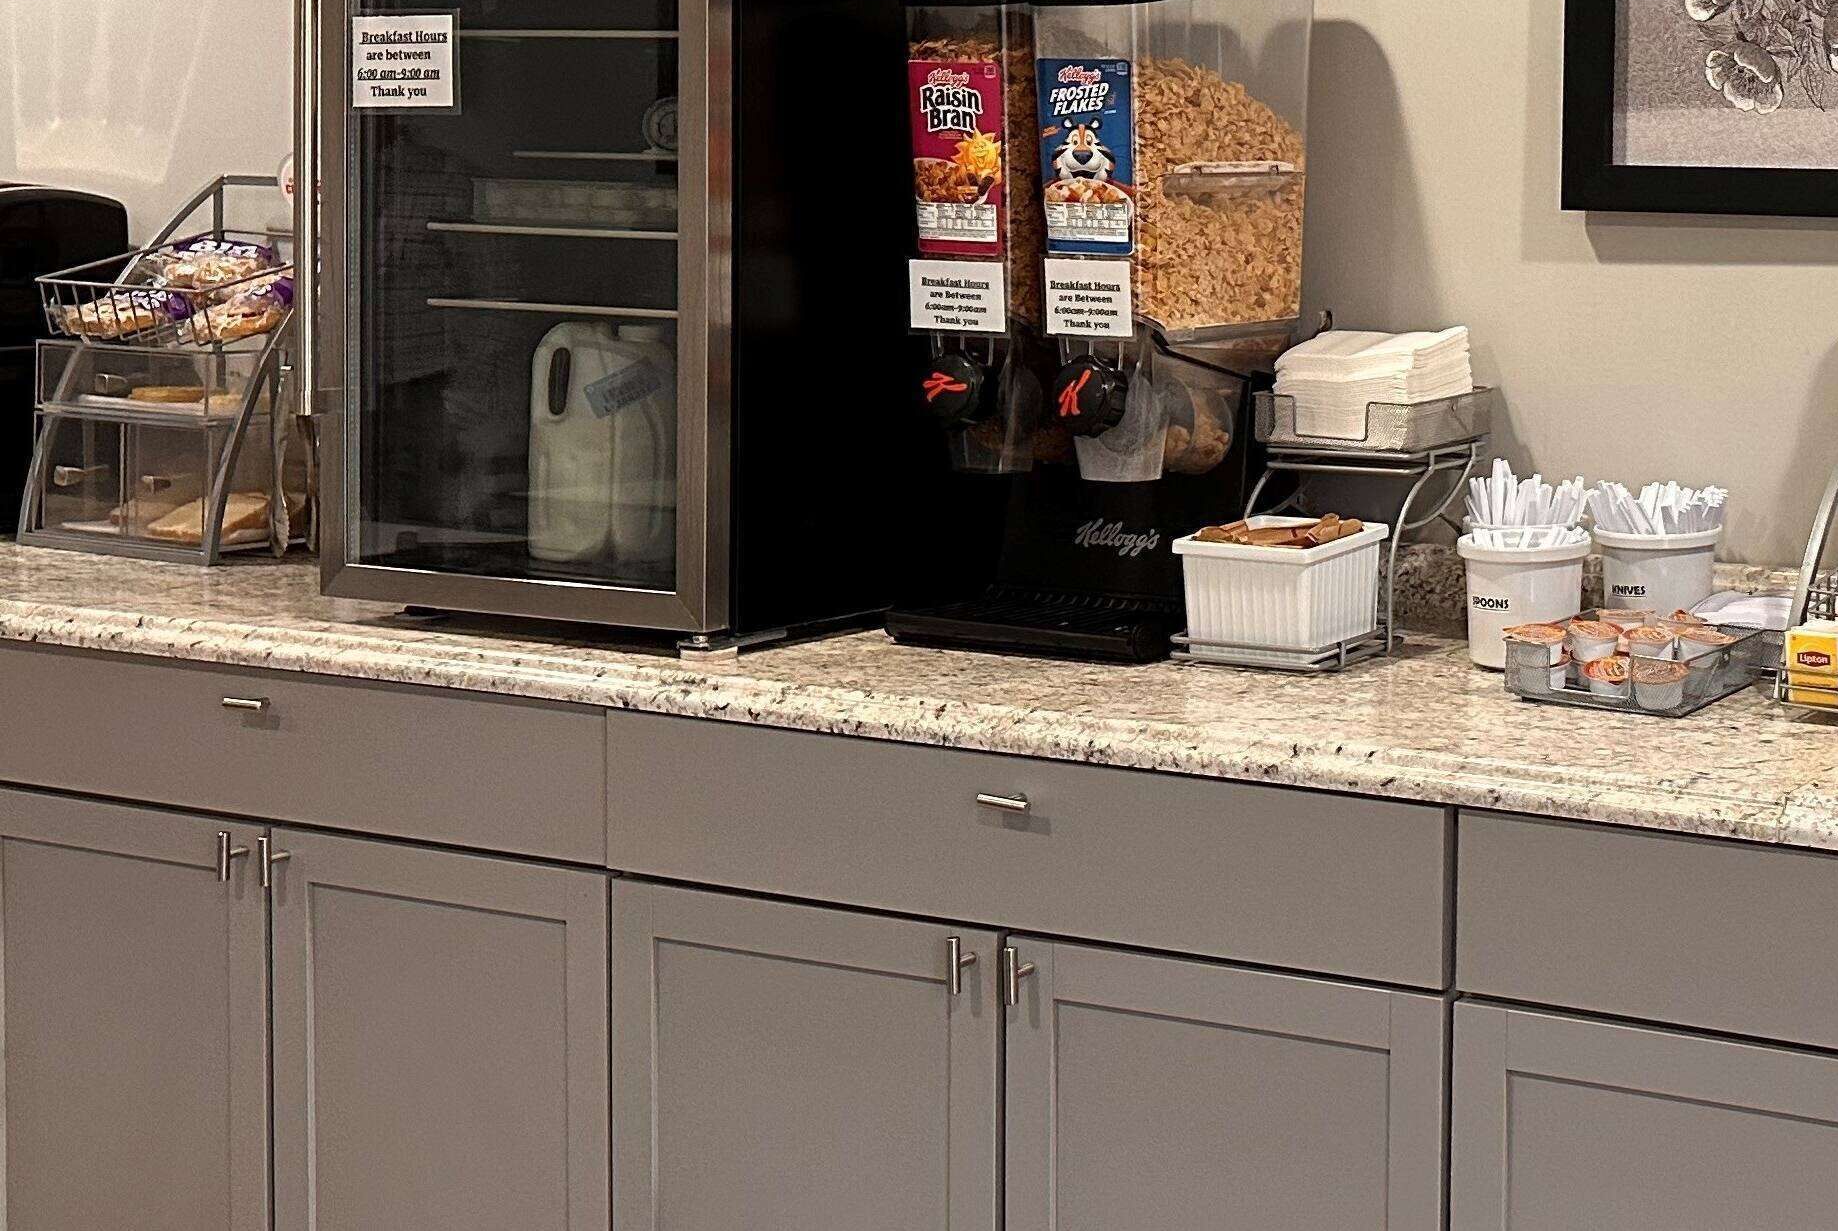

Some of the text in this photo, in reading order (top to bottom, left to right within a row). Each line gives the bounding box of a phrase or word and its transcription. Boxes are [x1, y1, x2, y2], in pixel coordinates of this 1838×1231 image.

[361, 30, 448, 43] Breakfast Hours
[366, 49, 431, 60] are between
[423, 69, 440, 79] am
[371, 85, 427, 99] Thank you
[1050, 82, 1109, 102] FROSTED
[921, 86, 981, 112] Raisin
[1053, 97, 1104, 116] FLAKES
[929, 108, 975, 130] Bran
[921, 277, 989, 289] Breakfast Hours
[1050, 280, 1120, 292] Breakfast Hours
[945, 291, 981, 300] Between
[1075, 294, 1112, 304] Between
[934, 315, 979, 326] Thank you
[1063, 320, 1110, 330] Thank you
[1075, 517, 1160, 556] Kellogg's
[1612, 584, 1646, 596] KNIVES
[1799, 653, 1829, 666] Lipton
